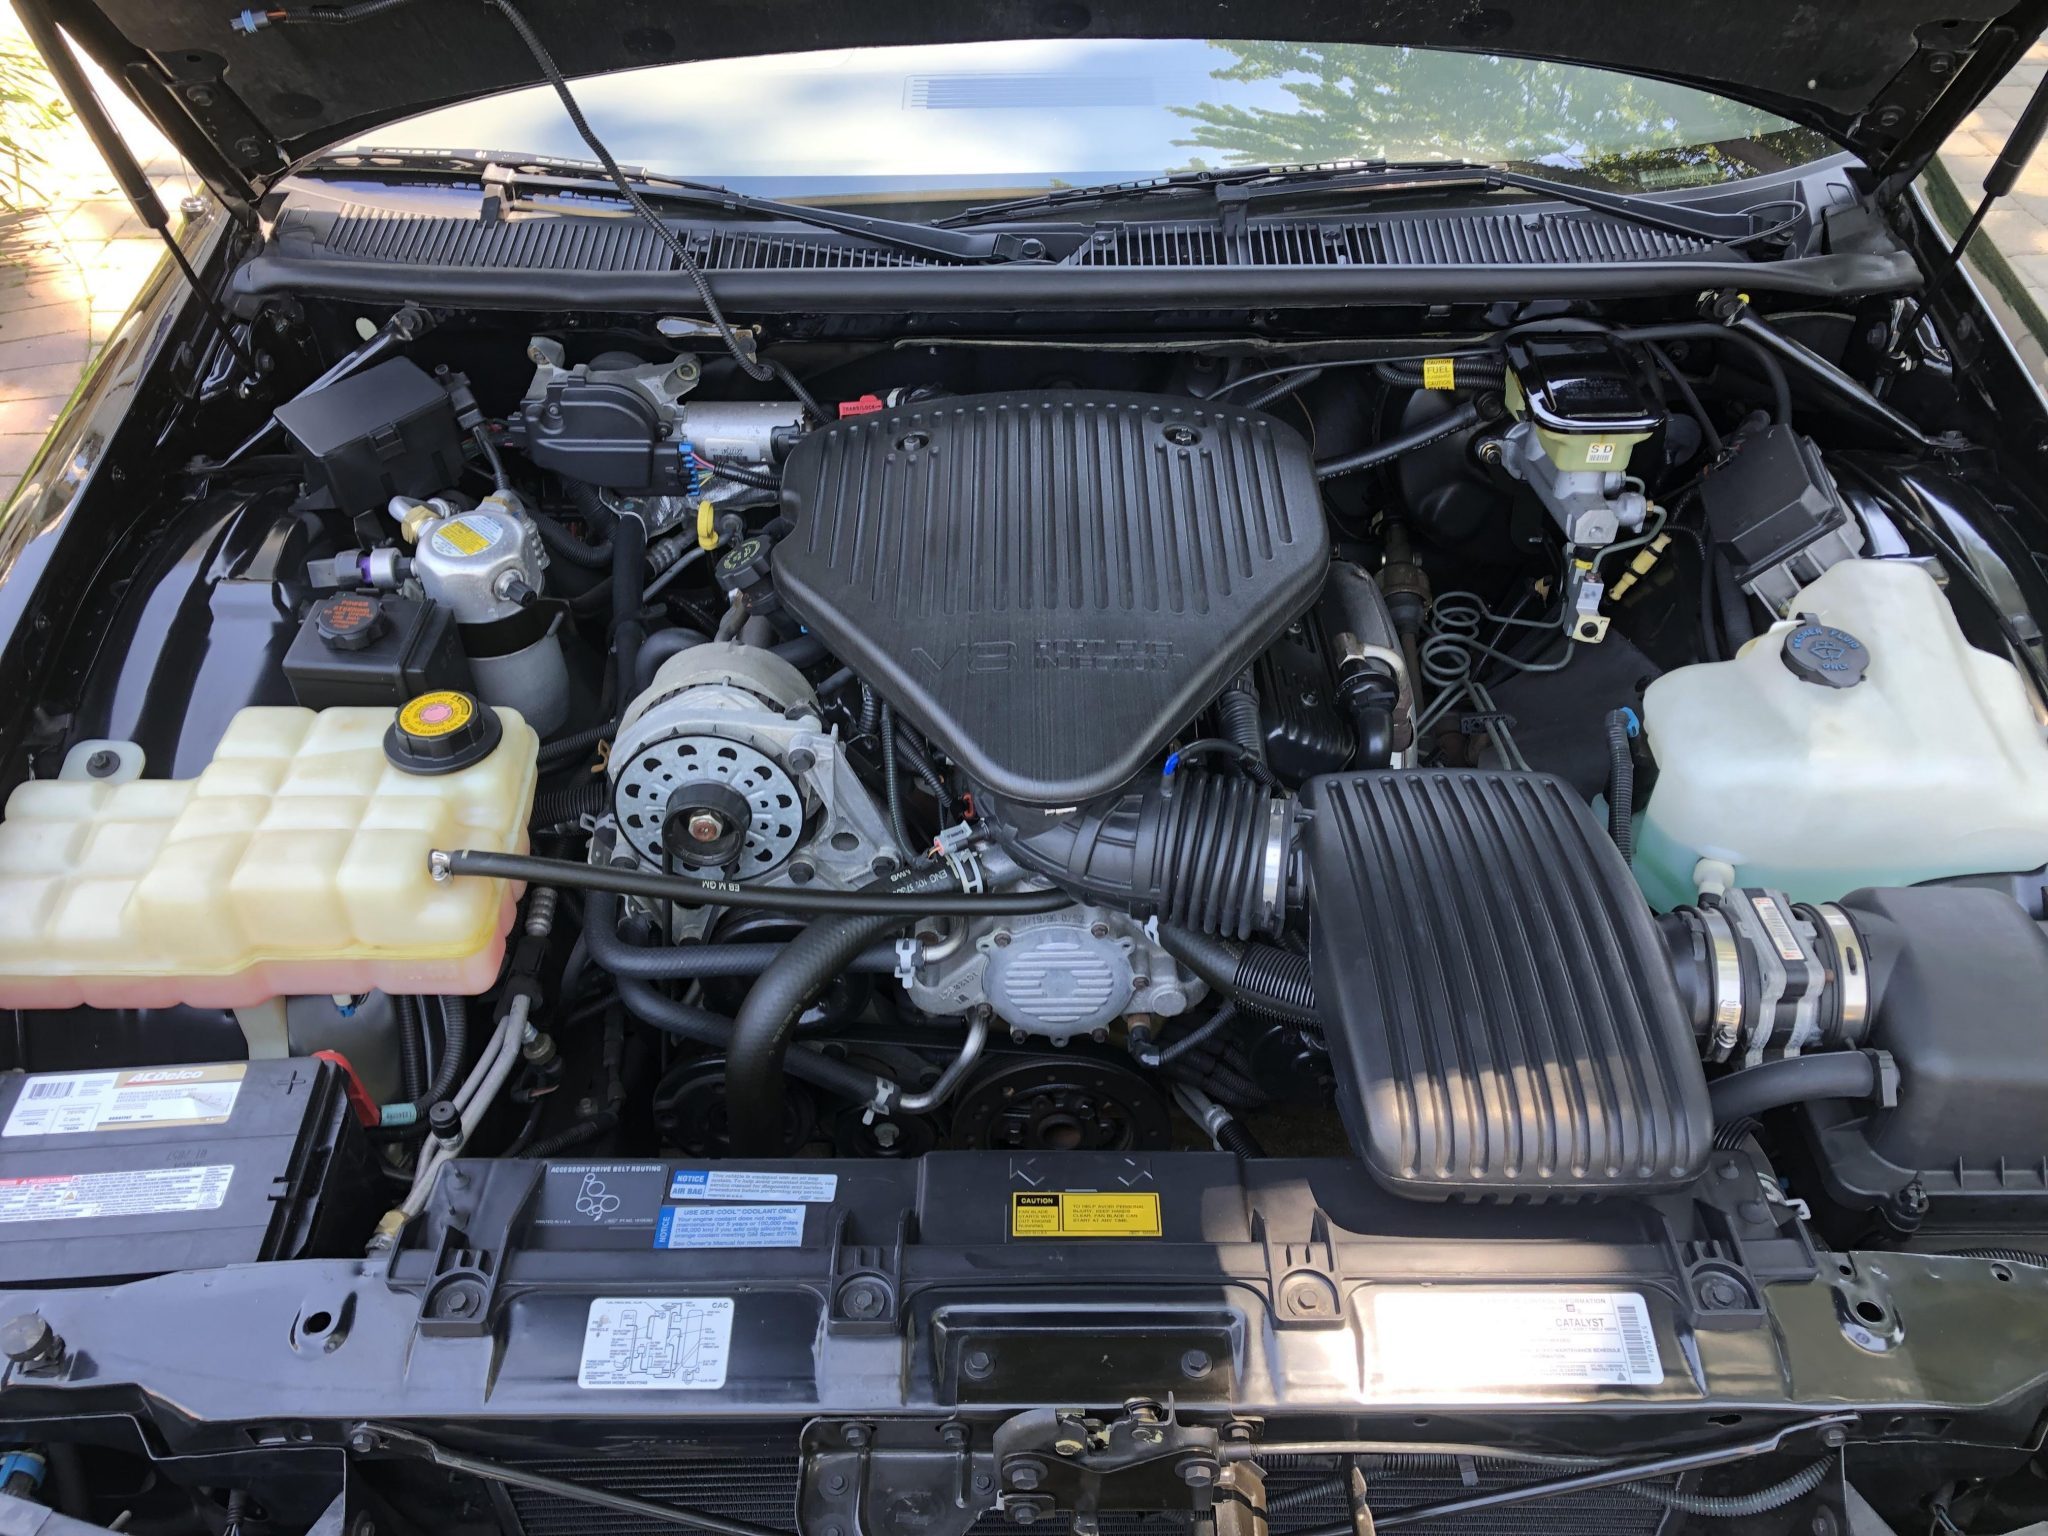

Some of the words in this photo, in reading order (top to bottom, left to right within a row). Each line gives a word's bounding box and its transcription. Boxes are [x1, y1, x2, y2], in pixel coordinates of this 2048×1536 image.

[1427, 366, 1452, 374] FUEL
[1591, 444, 1600, 453] S
[1603, 444, 1613, 453] D
[128, 1070, 204, 1083] ACDelco
[676, 1174, 705, 1183] NOTICE
[672, 1187, 686, 1195] AIR
[687, 1187, 703, 1195] BAG
[659, 1216, 671, 1243] NOTICE
[720, 1231, 746, 1239] meeting
[1555, 1318, 1604, 1328] CATALYST
